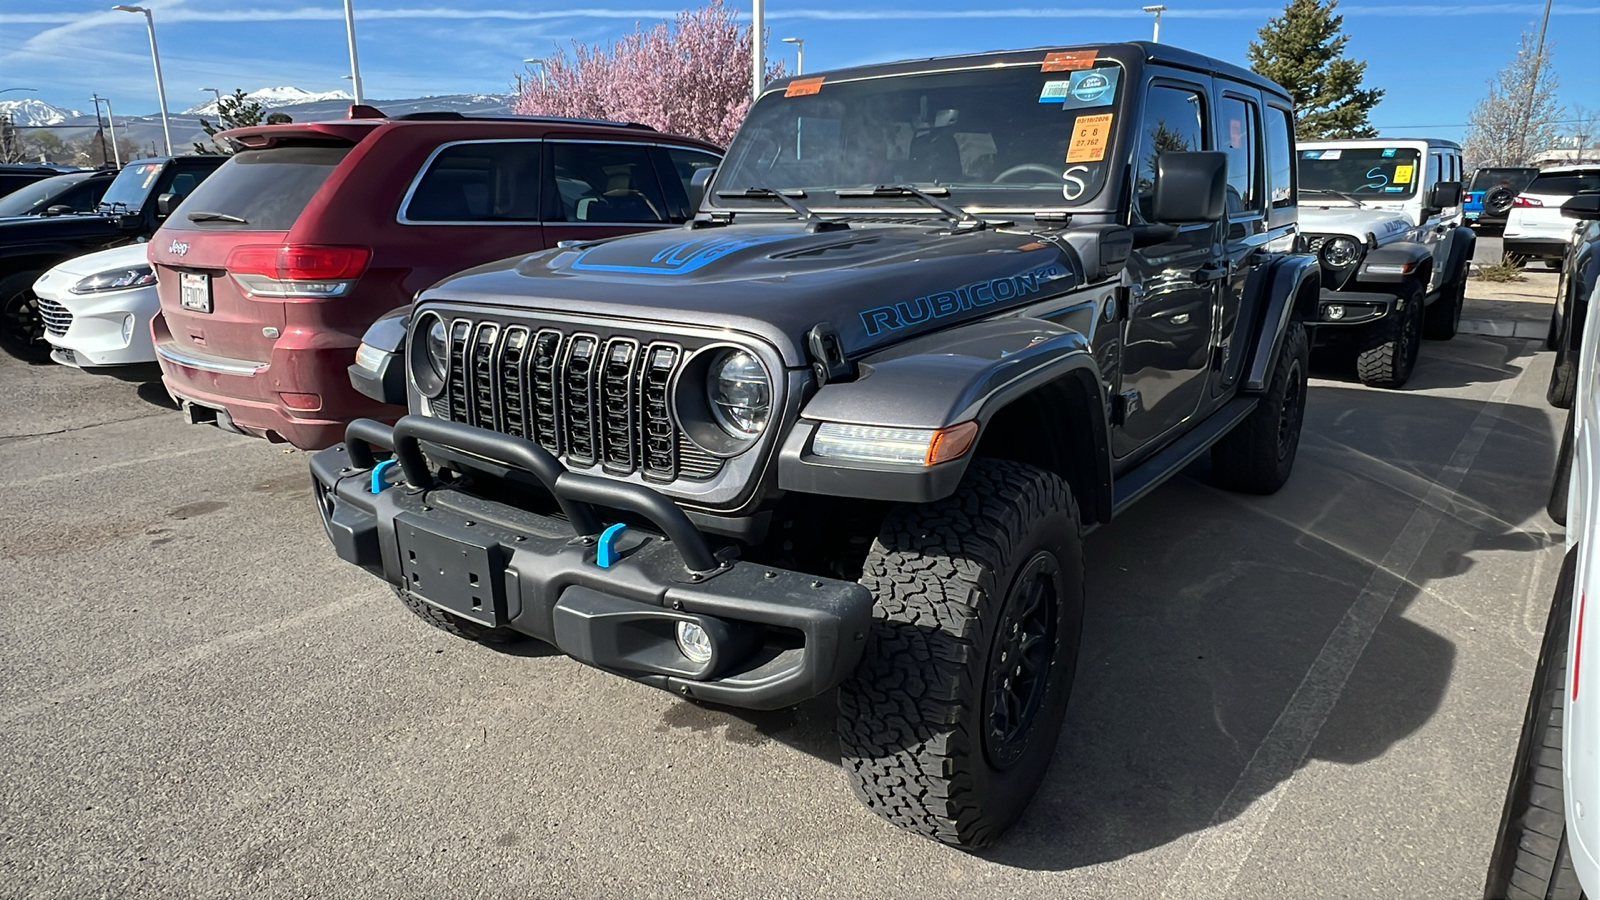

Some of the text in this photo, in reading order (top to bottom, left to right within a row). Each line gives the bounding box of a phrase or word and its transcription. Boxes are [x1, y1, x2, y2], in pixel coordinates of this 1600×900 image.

[1080, 128, 1098, 137] C 8
[1062, 165, 1089, 201] S
[1366, 166, 1388, 189] S
[169, 239, 188, 256] Jeep
[859, 272, 1040, 337] RUBICON
